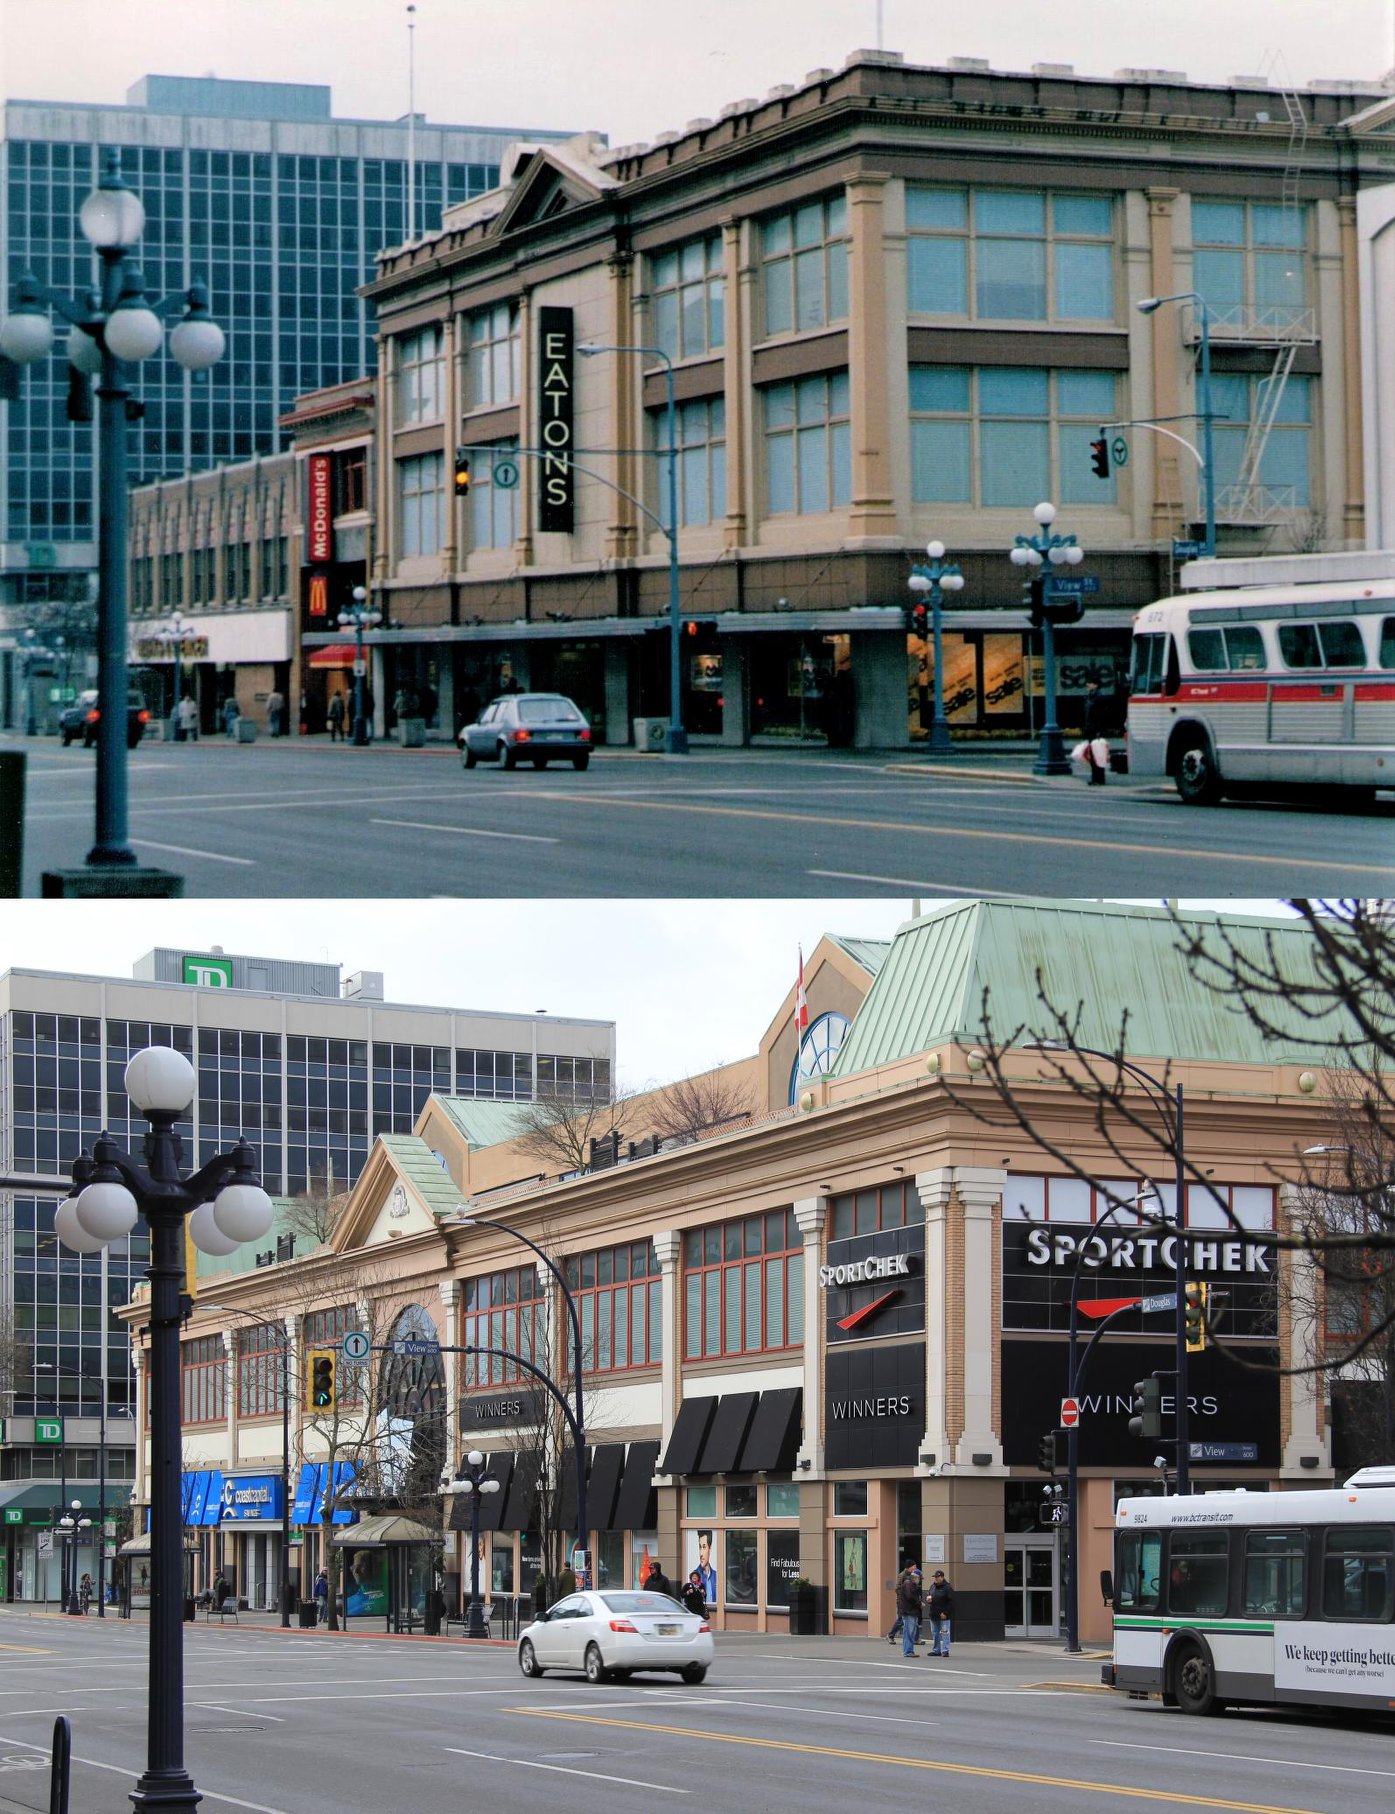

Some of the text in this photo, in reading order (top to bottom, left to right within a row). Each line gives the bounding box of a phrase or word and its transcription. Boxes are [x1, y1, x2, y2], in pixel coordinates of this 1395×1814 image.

[544, 333, 569, 505] EATONS
[314, 459, 327, 557] McDonald's
[1057, 579, 1081, 590] View
[986, 677, 1023, 704] sale
[1151, 1297, 1170, 1308] Douglas
[408, 1343, 426, 1353] View
[476, 1401, 520, 1418] WINNERS
[832, 1396, 910, 1419] WINNERS
[1078, 1395, 1218, 1415] WINERS
[38, 1423, 61, 1438] TD
[1204, 1446, 1225, 1456] View
[7, 1511, 21, 1521] TD
[1134, 1514, 1147, 1523] 9824
[1171, 1513, 1233, 1522] www.bctransit.com
[770, 1558, 800, 1567] Find Fabulous
[788, 1569, 800, 1578] Less
[1285, 1644, 1395, 1668] We keep getting bette
[1305, 1665, 1327, 1674] (because
[1336, 1667, 1347, 1675] can't
